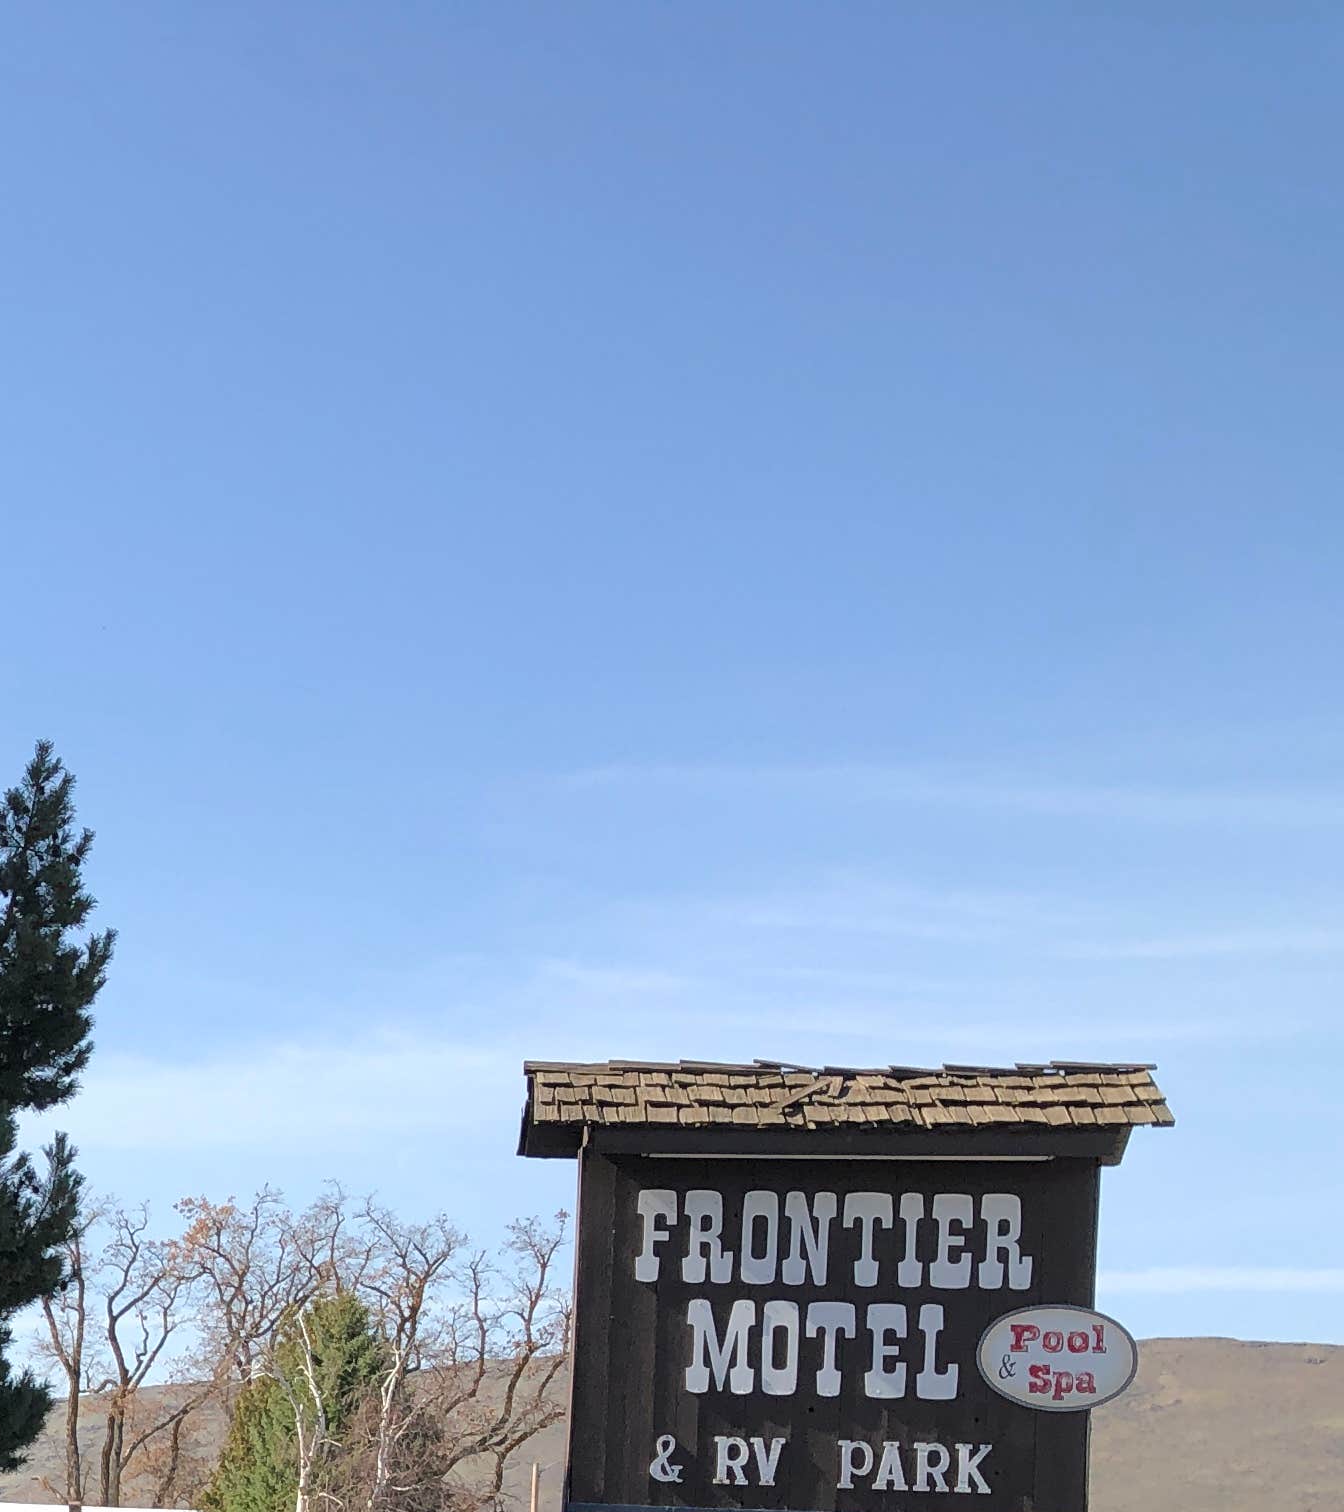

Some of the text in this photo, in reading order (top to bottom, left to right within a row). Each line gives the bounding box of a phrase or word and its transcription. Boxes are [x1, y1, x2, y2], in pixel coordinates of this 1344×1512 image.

[635, 1188, 1033, 1291] FRONTIER
[685, 1299, 958, 1401] MOTEL
[1009, 1323, 1107, 1355] Pool
[998, 1353, 1097, 1402] & Spa
[649, 1433, 993, 1495] & RV PARK
